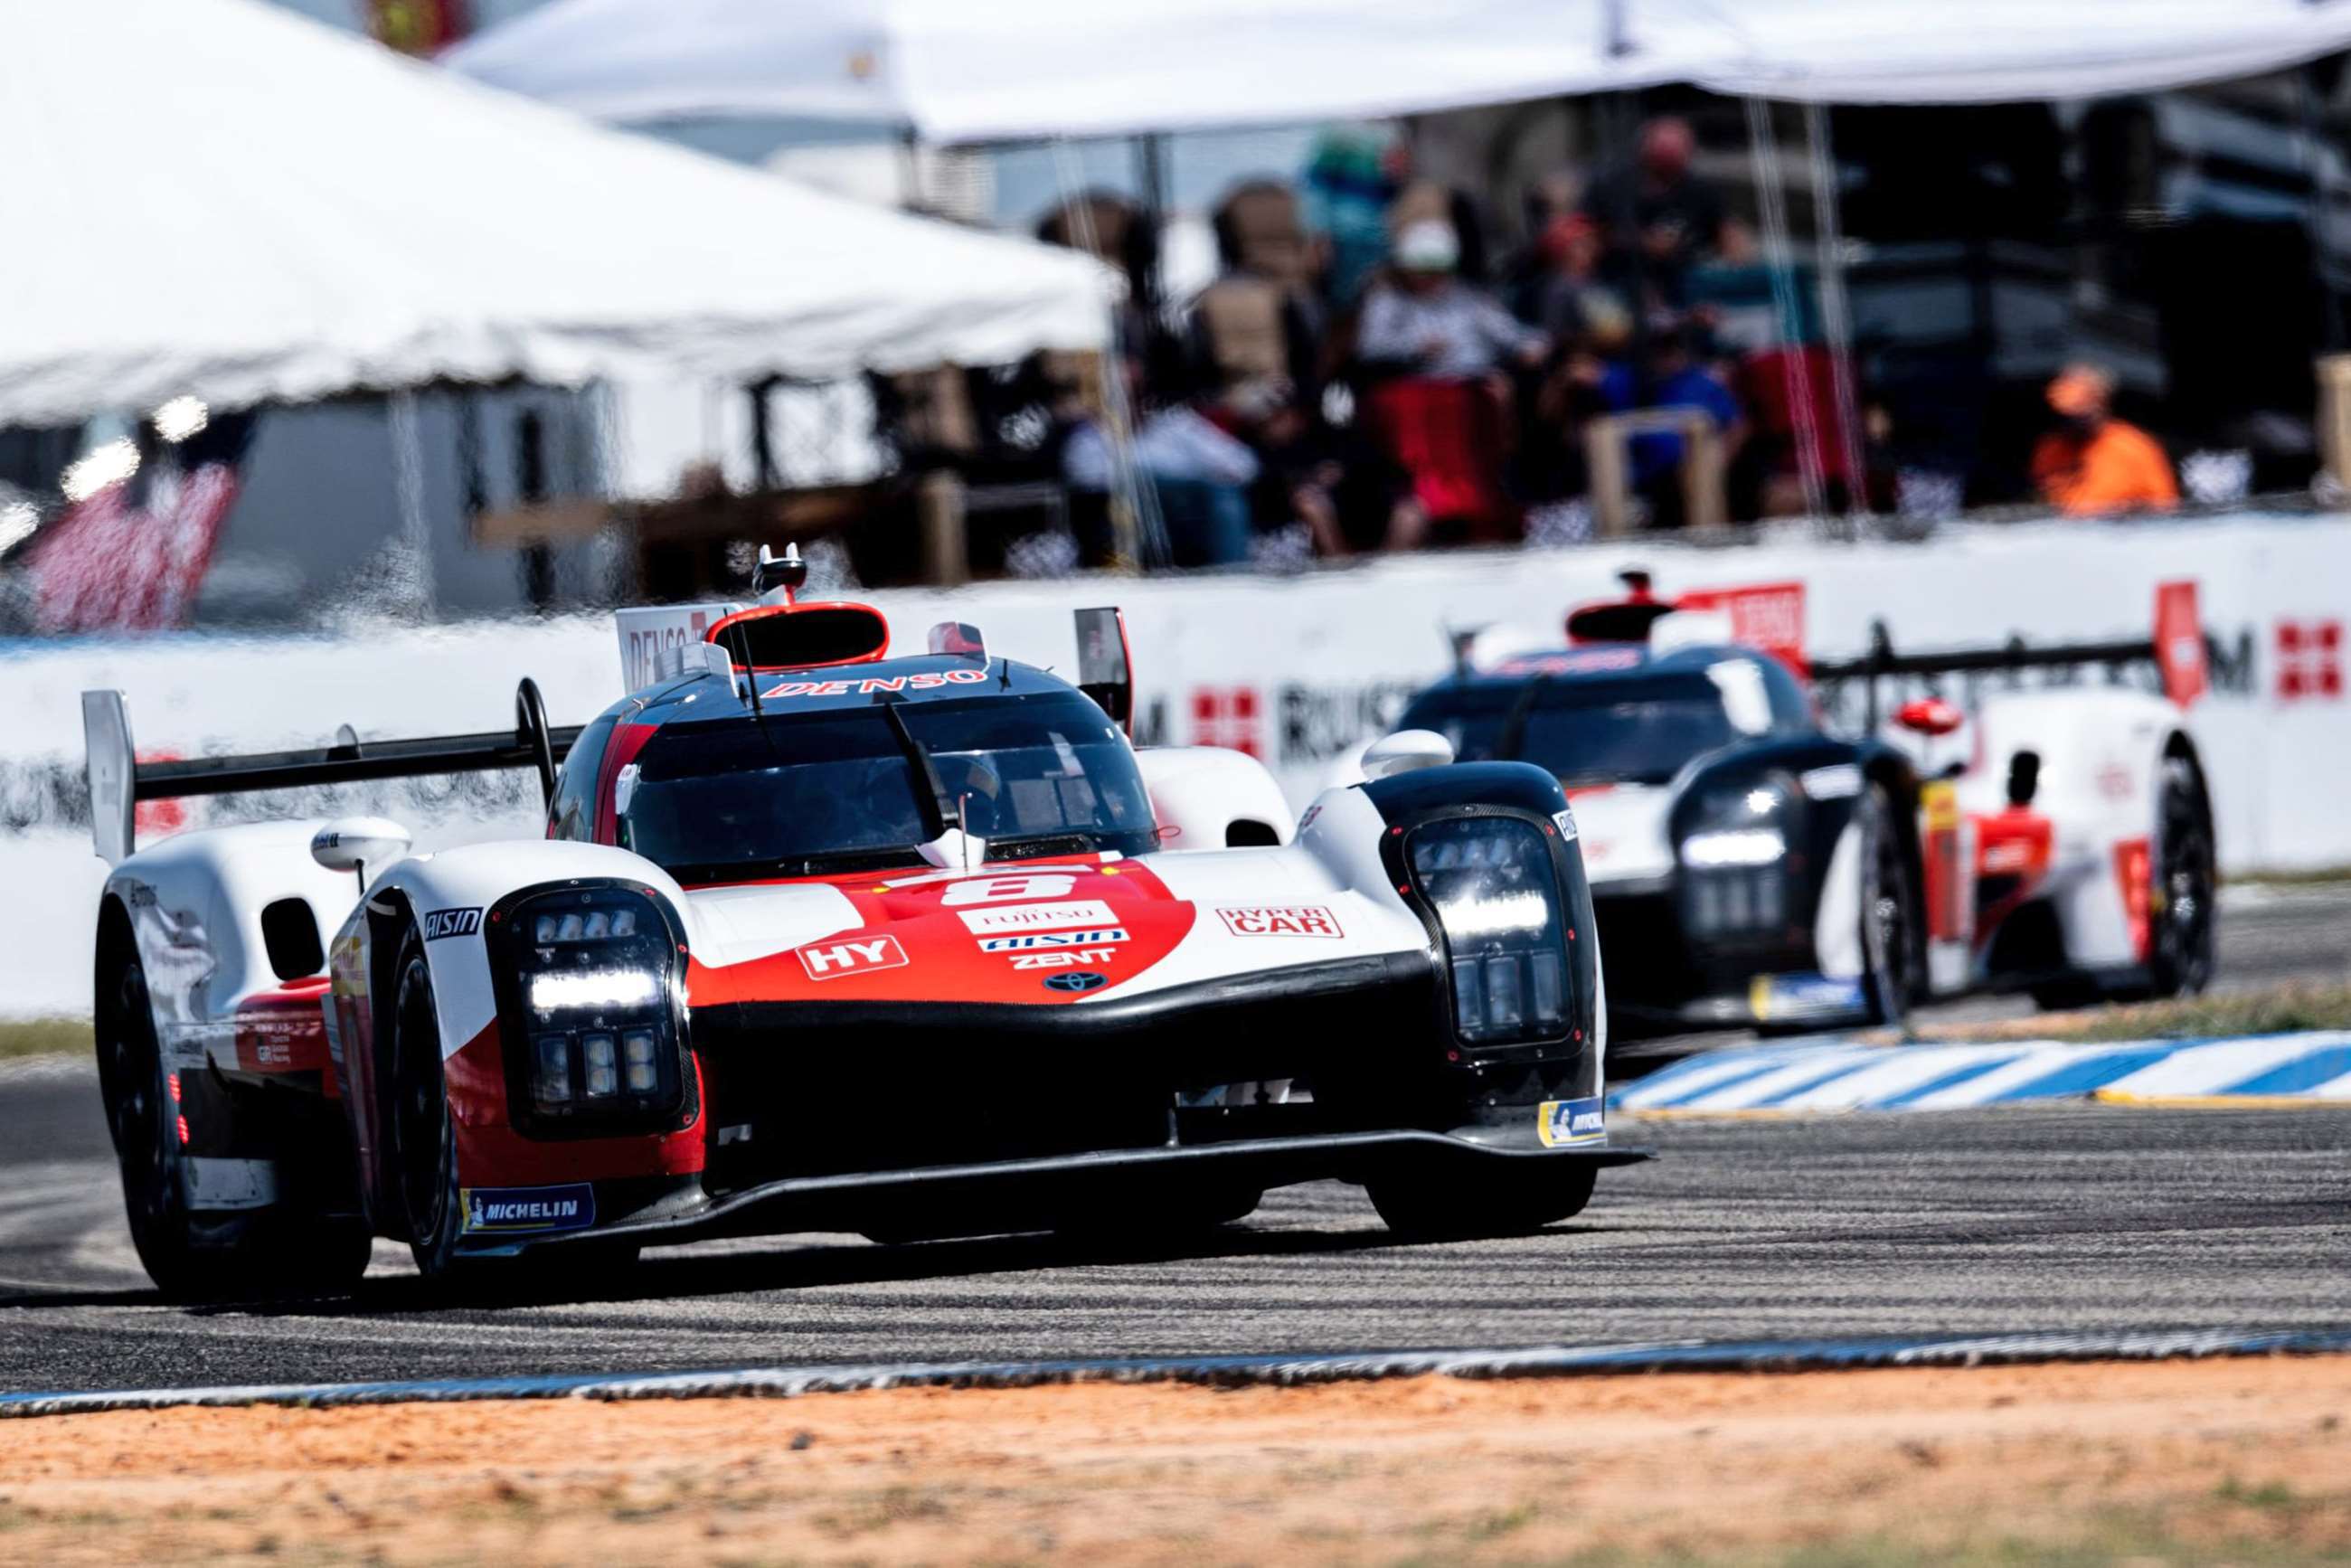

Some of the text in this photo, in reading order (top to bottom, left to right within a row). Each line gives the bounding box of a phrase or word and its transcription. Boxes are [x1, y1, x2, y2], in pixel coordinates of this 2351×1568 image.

[760, 669, 987, 698] DENSO
[940, 874, 1077, 906] 8
[983, 909, 1094, 925] FUJITSU
[1225, 908, 1323, 918] HYPER
[426, 909, 480, 939] AISIN
[1234, 918, 1333, 934] CAR
[987, 931, 1122, 950] AISIN
[805, 940, 887, 973] HY
[1008, 948, 1118, 970] ZENT
[486, 1199, 579, 1220] MICHELIN
